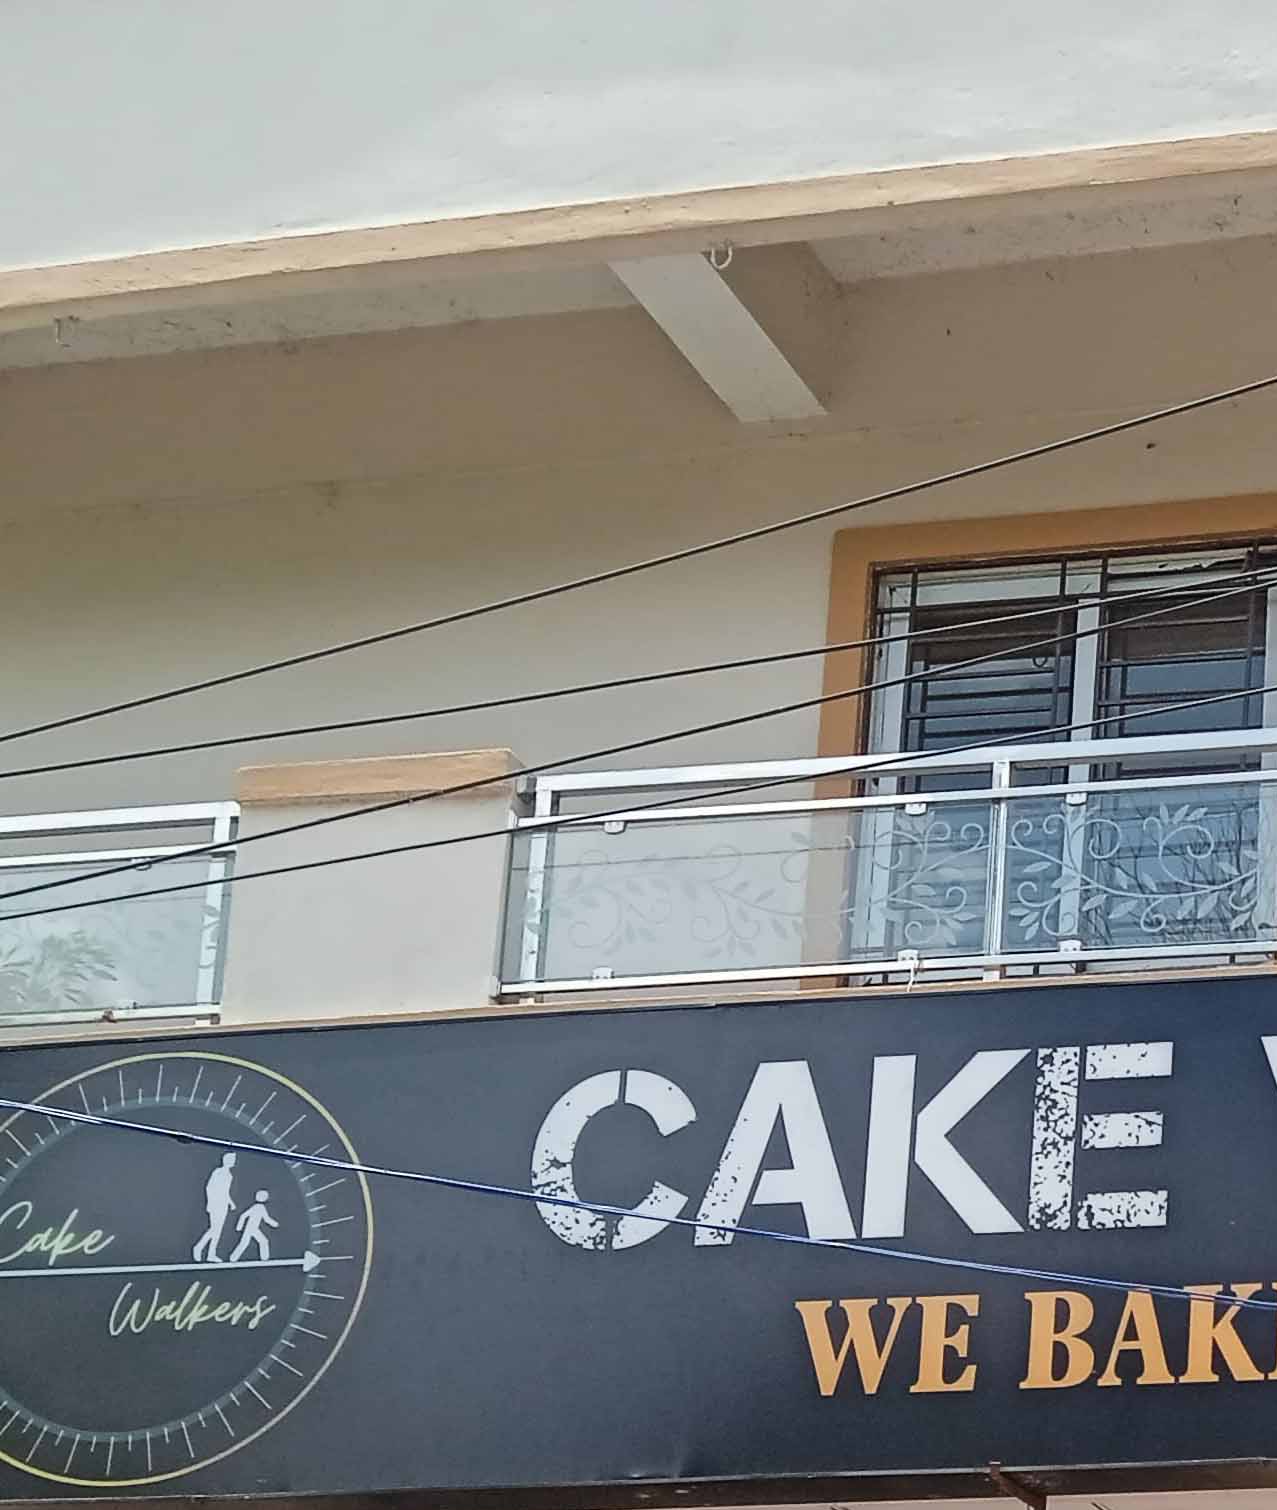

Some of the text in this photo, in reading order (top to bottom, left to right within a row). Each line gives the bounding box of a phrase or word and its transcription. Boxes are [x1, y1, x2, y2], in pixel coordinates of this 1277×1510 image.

[530, 1041, 1174, 1251] CAKE
[109, 1280, 277, 1336] Walkers
[796, 1293, 981, 1396] WE
